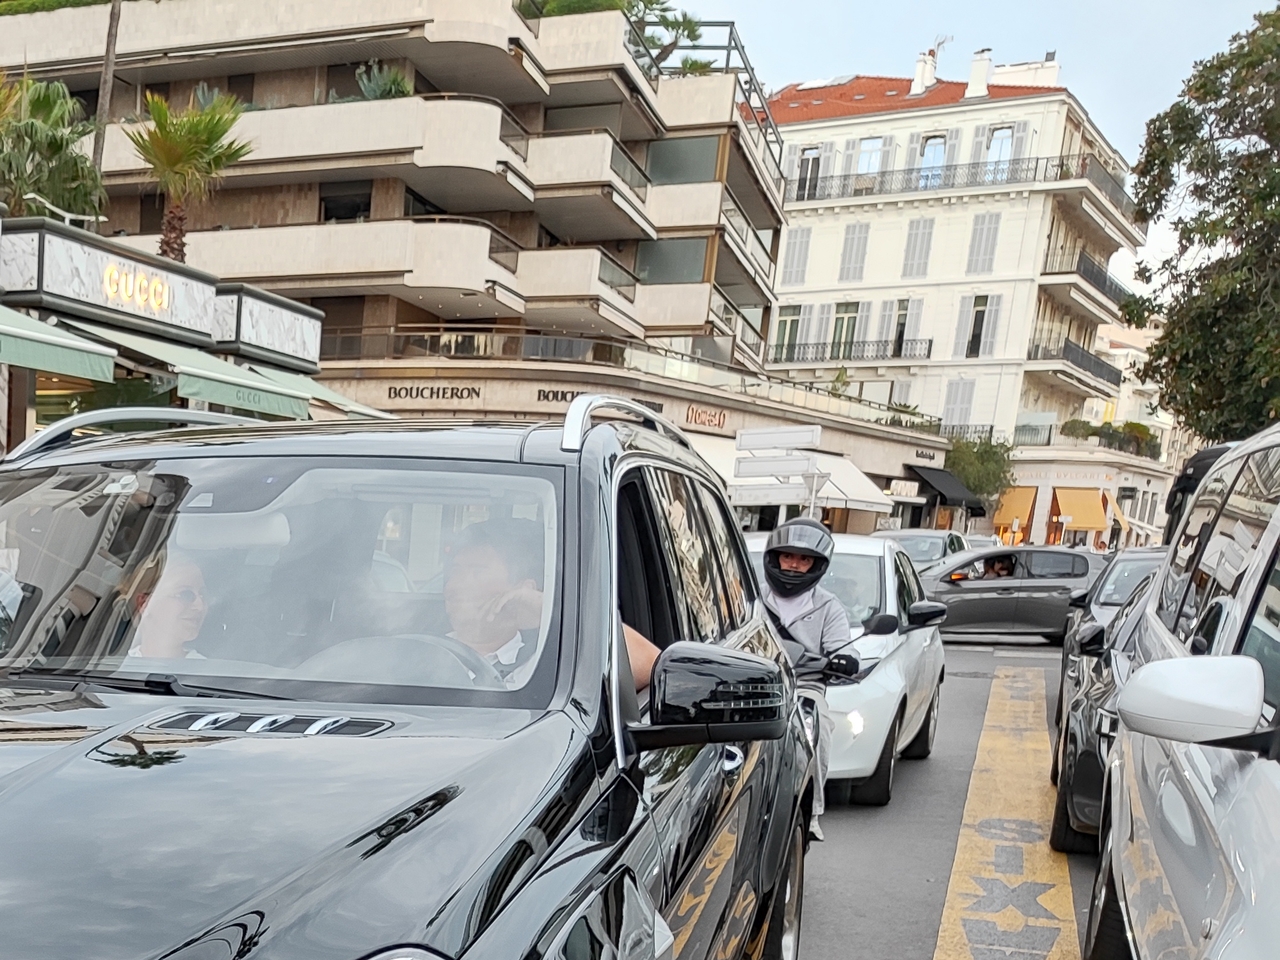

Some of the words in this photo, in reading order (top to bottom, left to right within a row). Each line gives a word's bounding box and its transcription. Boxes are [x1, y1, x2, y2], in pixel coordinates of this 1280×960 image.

[105, 265, 170, 310] GUCCI
[235, 390, 261, 405] GUCCI
[387, 386, 481, 400] BOUCHERON
[537, 389, 588, 402] BOUCH
